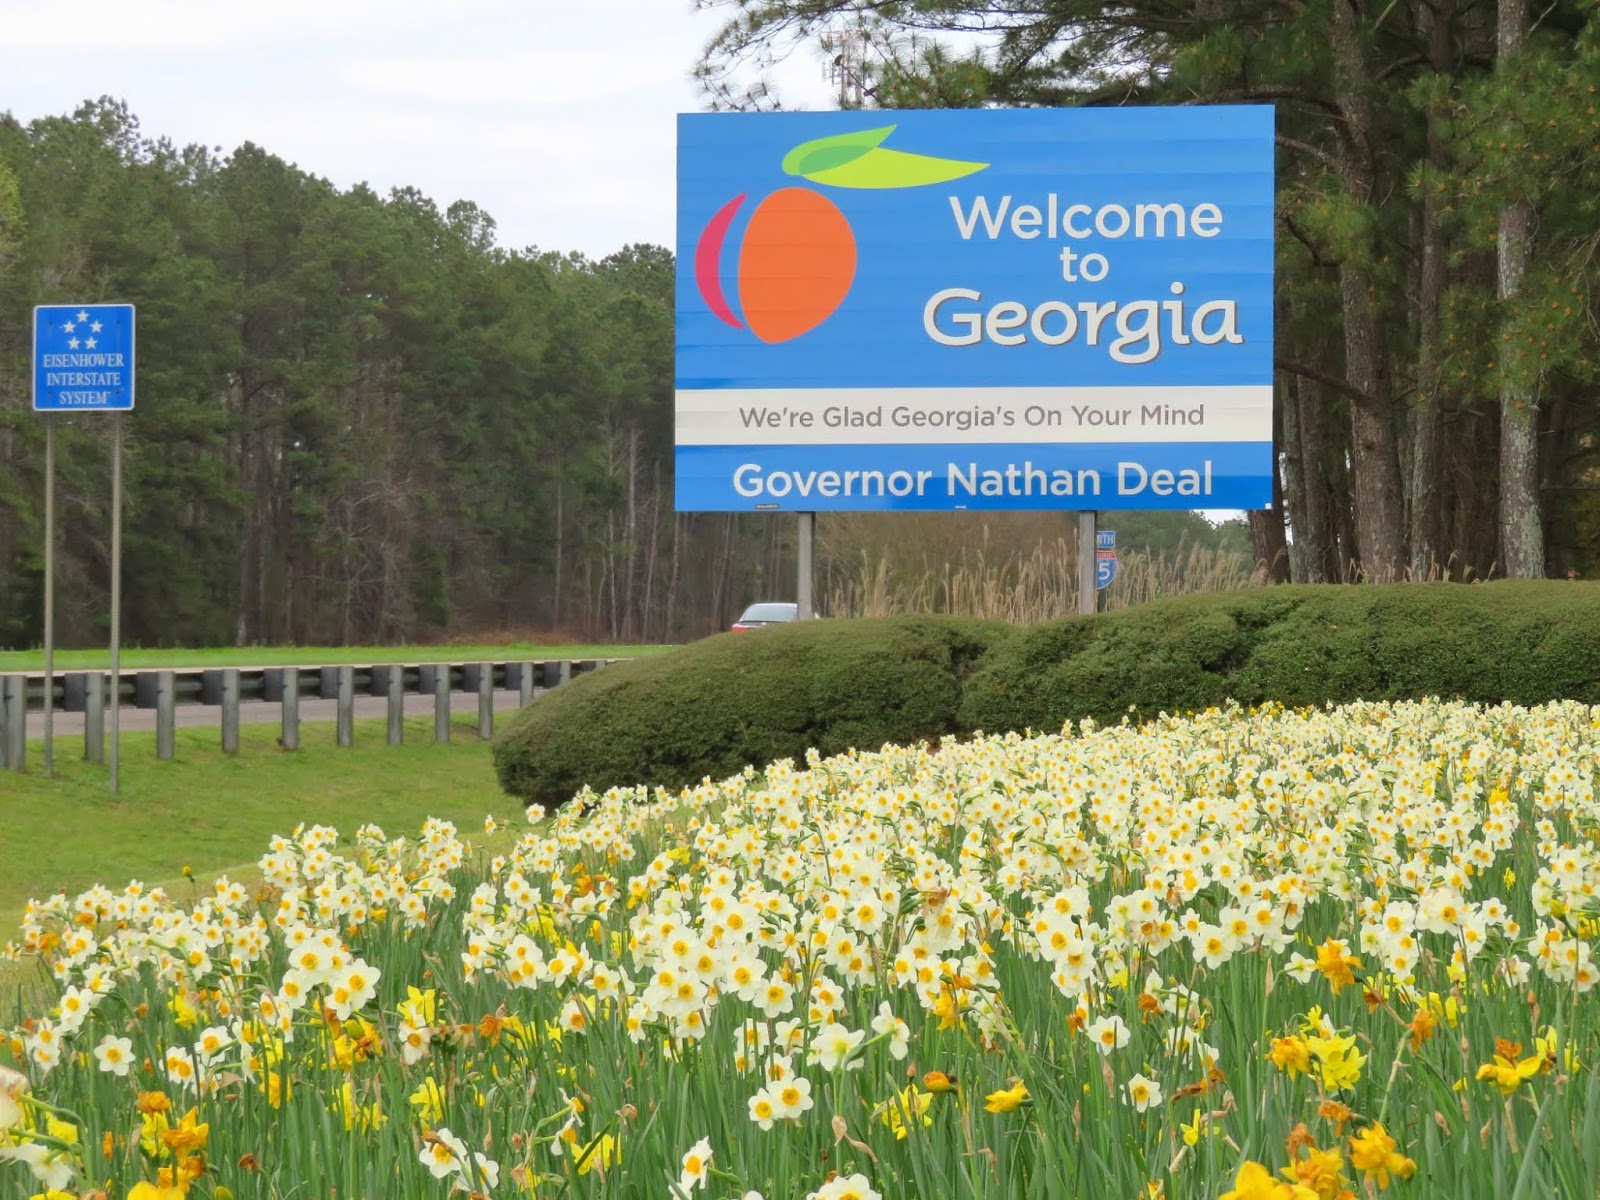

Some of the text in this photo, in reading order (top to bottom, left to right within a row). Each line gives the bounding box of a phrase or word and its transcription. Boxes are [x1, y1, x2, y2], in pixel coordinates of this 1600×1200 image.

[948, 192, 1224, 241] Welcome
[1059, 245, 1110, 283] to
[923, 281, 1245, 365] Georgia
[43, 353, 125, 368] EISENHOWER
[46, 372, 121, 386] INTERSTATE
[59, 391, 108, 405] SYSTEM
[739, 403, 1205, 431] We're Glad Georgia's On Your Mind
[733, 460, 1213, 498] Governor Nathan Deal
[1097, 534, 1114, 545] RTH
[1098, 562, 1110, 581] 5
